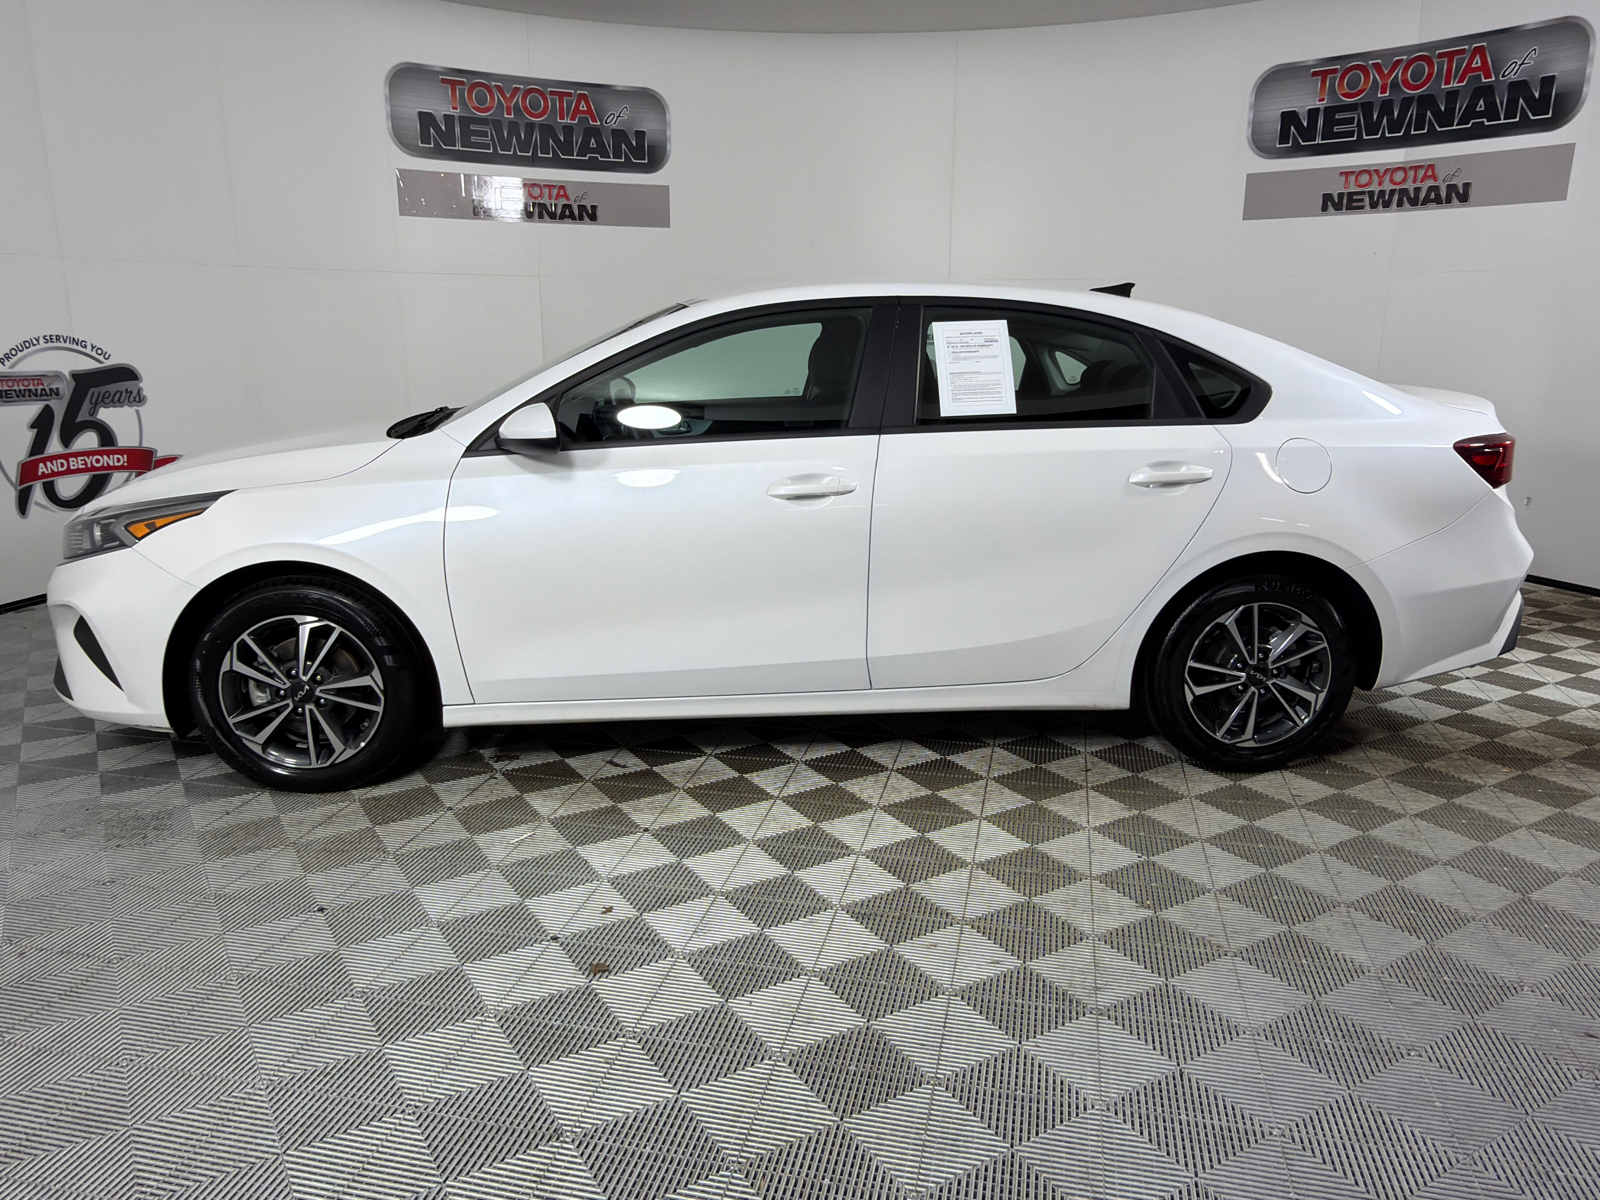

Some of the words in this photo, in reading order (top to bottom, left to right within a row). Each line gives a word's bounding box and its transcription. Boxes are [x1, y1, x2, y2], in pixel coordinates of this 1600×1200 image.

[1311, 43, 1495, 103] TOYOTA
[1500, 47, 1537, 79] of
[440, 76, 600, 124] TOYOTA
[604, 105, 629, 126] of
[1277, 74, 1557, 147] NEWNAN
[417, 110, 647, 163] NEWNAN
[1339, 163, 1438, 190] TOYOTA
[1442, 167, 1462, 183] of
[1320, 181, 1472, 214] NEWNAN
[0, 336, 41, 366] PROUDLY
[43, 334, 88, 349] SERVING
[90, 342, 112, 361] YOU
[0, 378, 45, 388] TOYOTA
[0, 387, 60, 399] EWNAN
[89, 387, 146, 417] years
[38, 460, 68, 476] AND
[69, 455, 128, 470] BEYOND!
